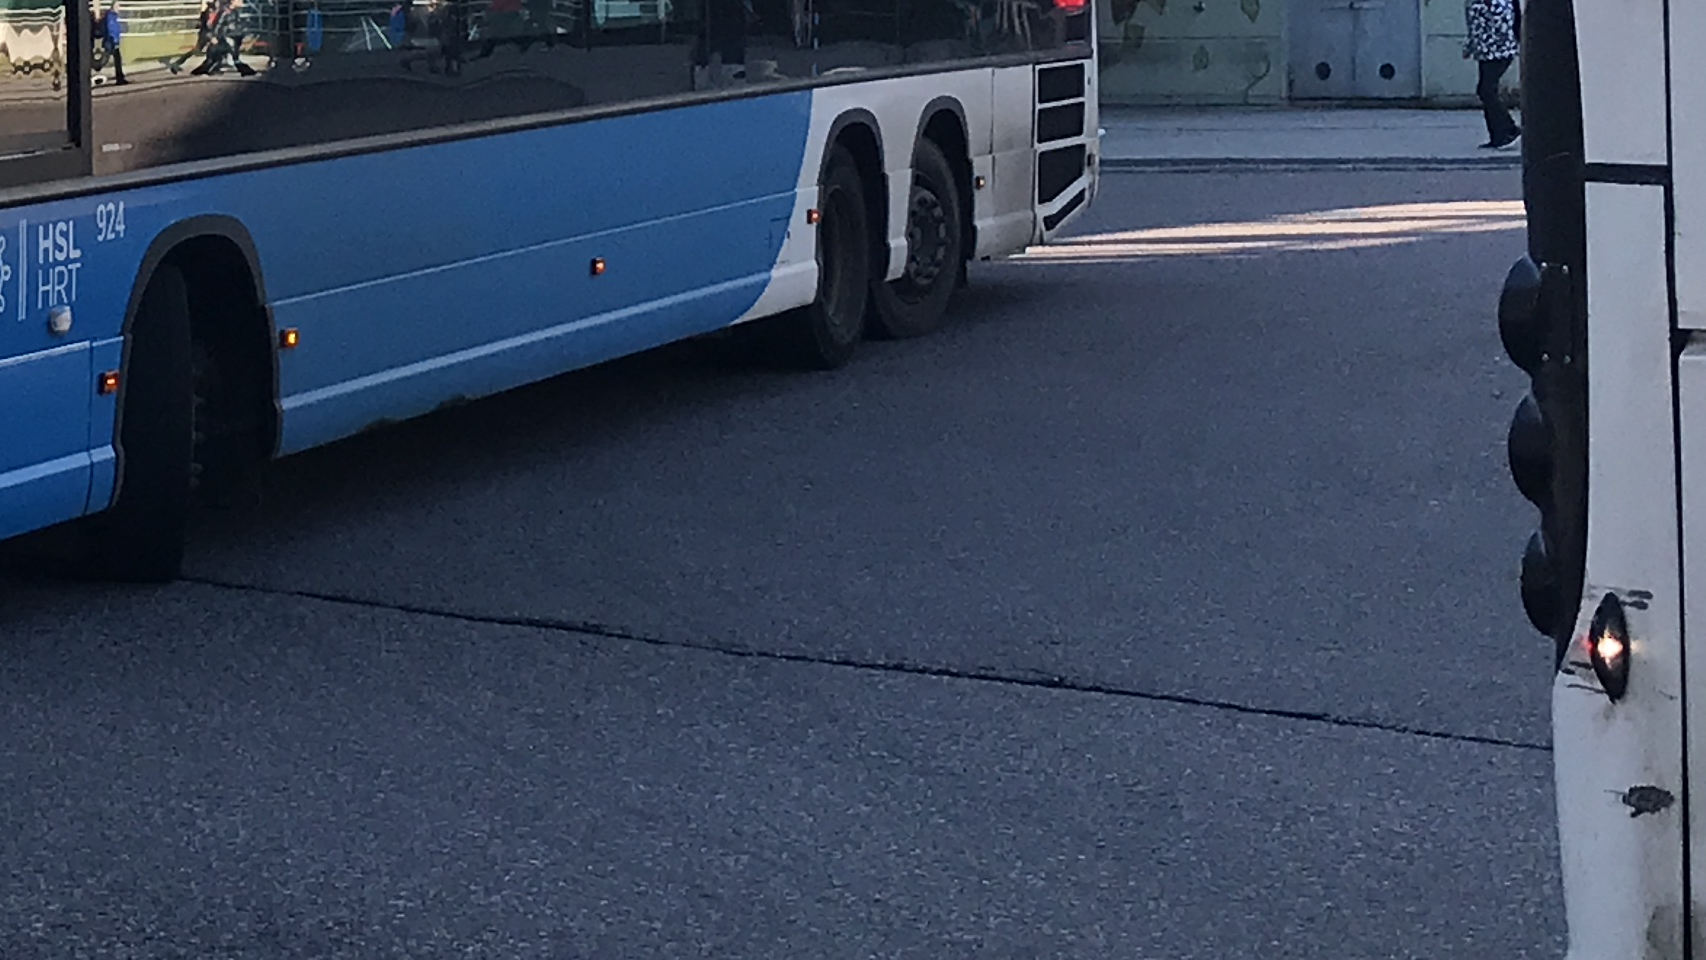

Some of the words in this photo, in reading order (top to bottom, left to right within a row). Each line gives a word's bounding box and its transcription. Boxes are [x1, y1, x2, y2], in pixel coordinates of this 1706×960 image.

[38, 220, 82, 265] HSL
[96, 201, 126, 242] 924
[37, 262, 82, 309] HRT
